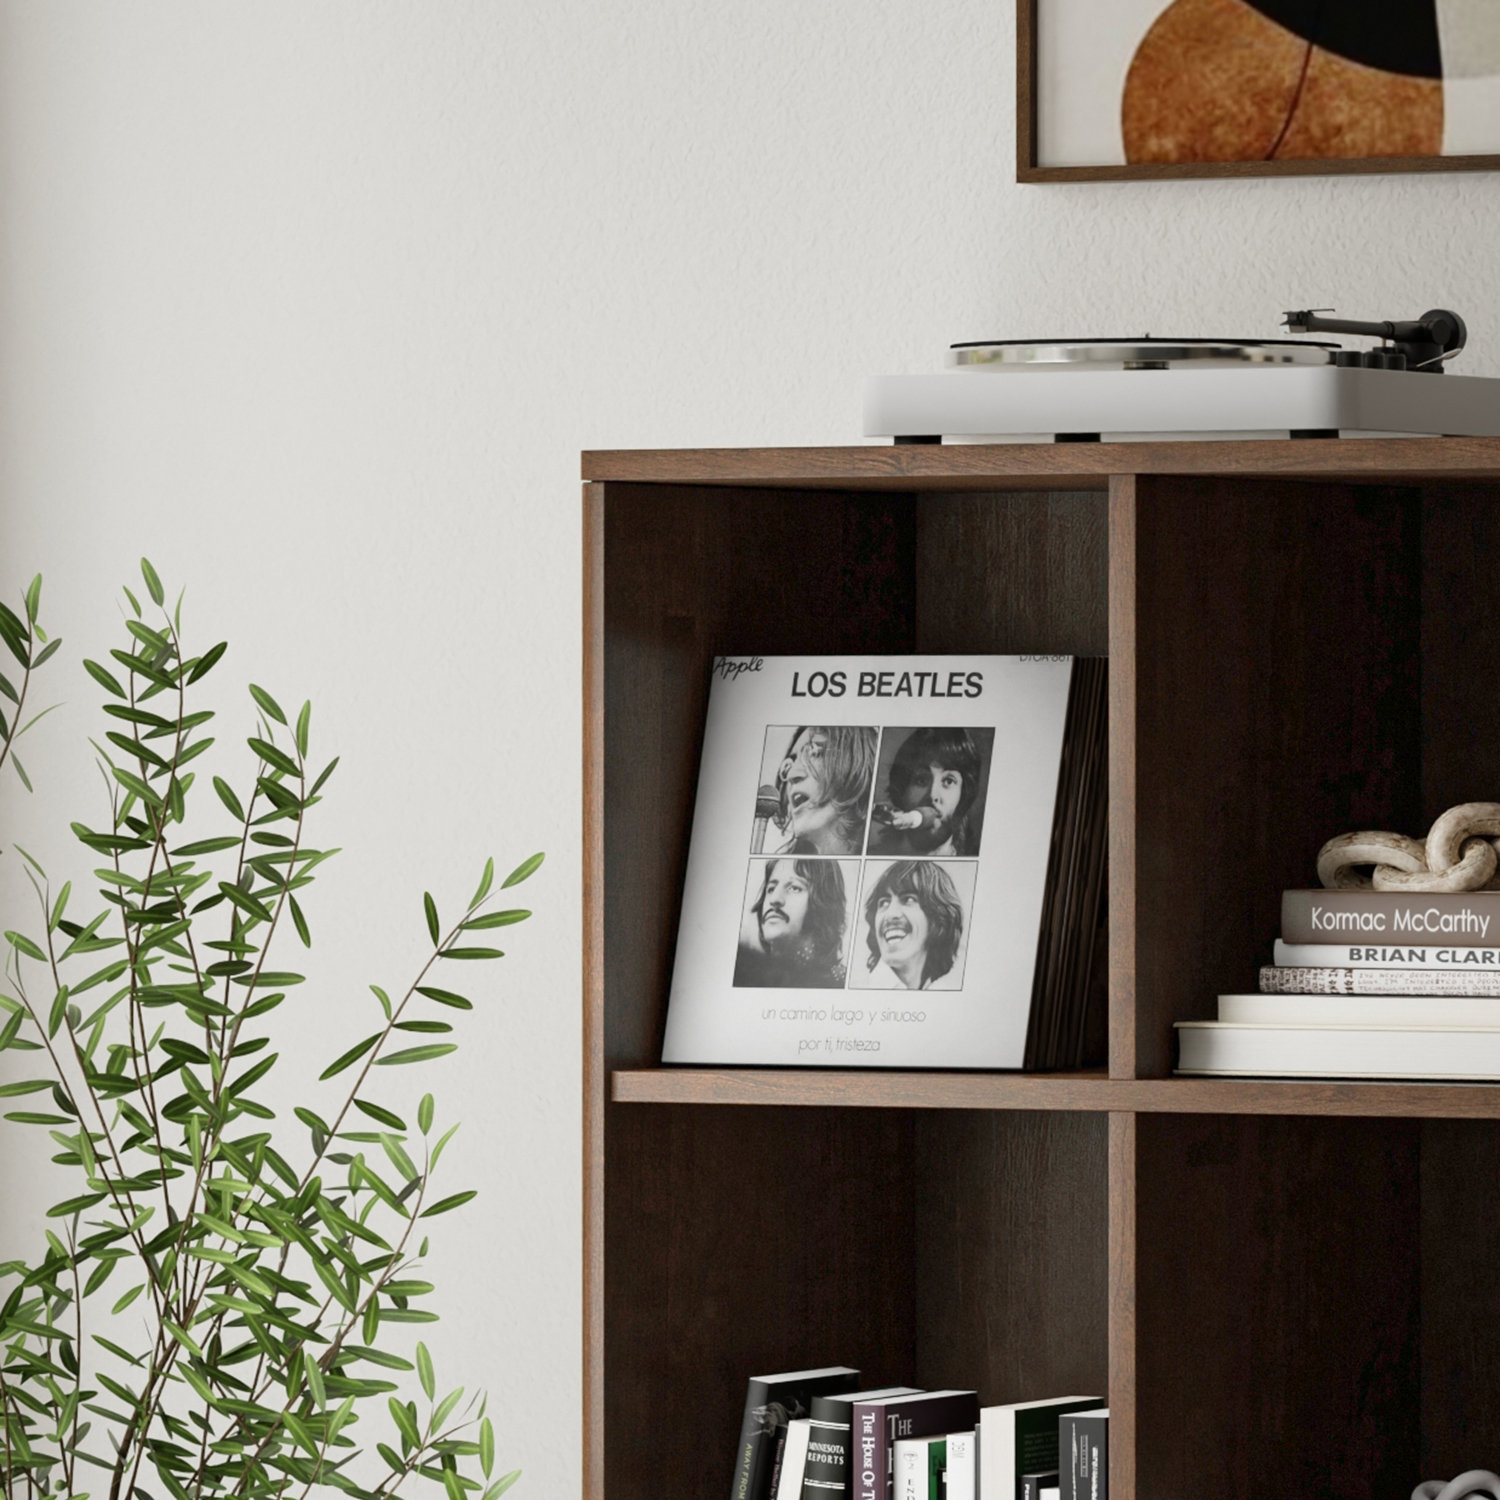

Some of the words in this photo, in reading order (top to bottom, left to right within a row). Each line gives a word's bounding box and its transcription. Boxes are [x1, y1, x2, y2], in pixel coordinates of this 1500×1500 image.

[712, 656, 764, 681] Apple
[791, 671, 847, 698] LOS
[857, 671, 984, 698] BEATLES
[1311, 907, 1386, 932] Kormac
[1393, 908, 1491, 938] McCarthy
[1349, 947, 1426, 964] BRIAN
[761, 1008, 776, 1020] un
[779, 1007, 827, 1021] camino
[830, 1004, 863, 1025] largo
[869, 1011, 878, 1025] y
[880, 1007, 927, 1023] sinuoso
[798, 1039, 822, 1055] por
[836, 1037, 881, 1052] tristeza
[862, 1413, 875, 1433] THE
[887, 1414, 912, 1440] THE
[743, 1443, 753, 1469] AWAY
[807, 1452, 844, 1465] REPORTS
[808, 1442, 844, 1454] MINNESOTA
[862, 1437, 875, 1468] HOUSE
[738, 1471, 748, 1498] FROM
[862, 1471, 875, 1486] OF
